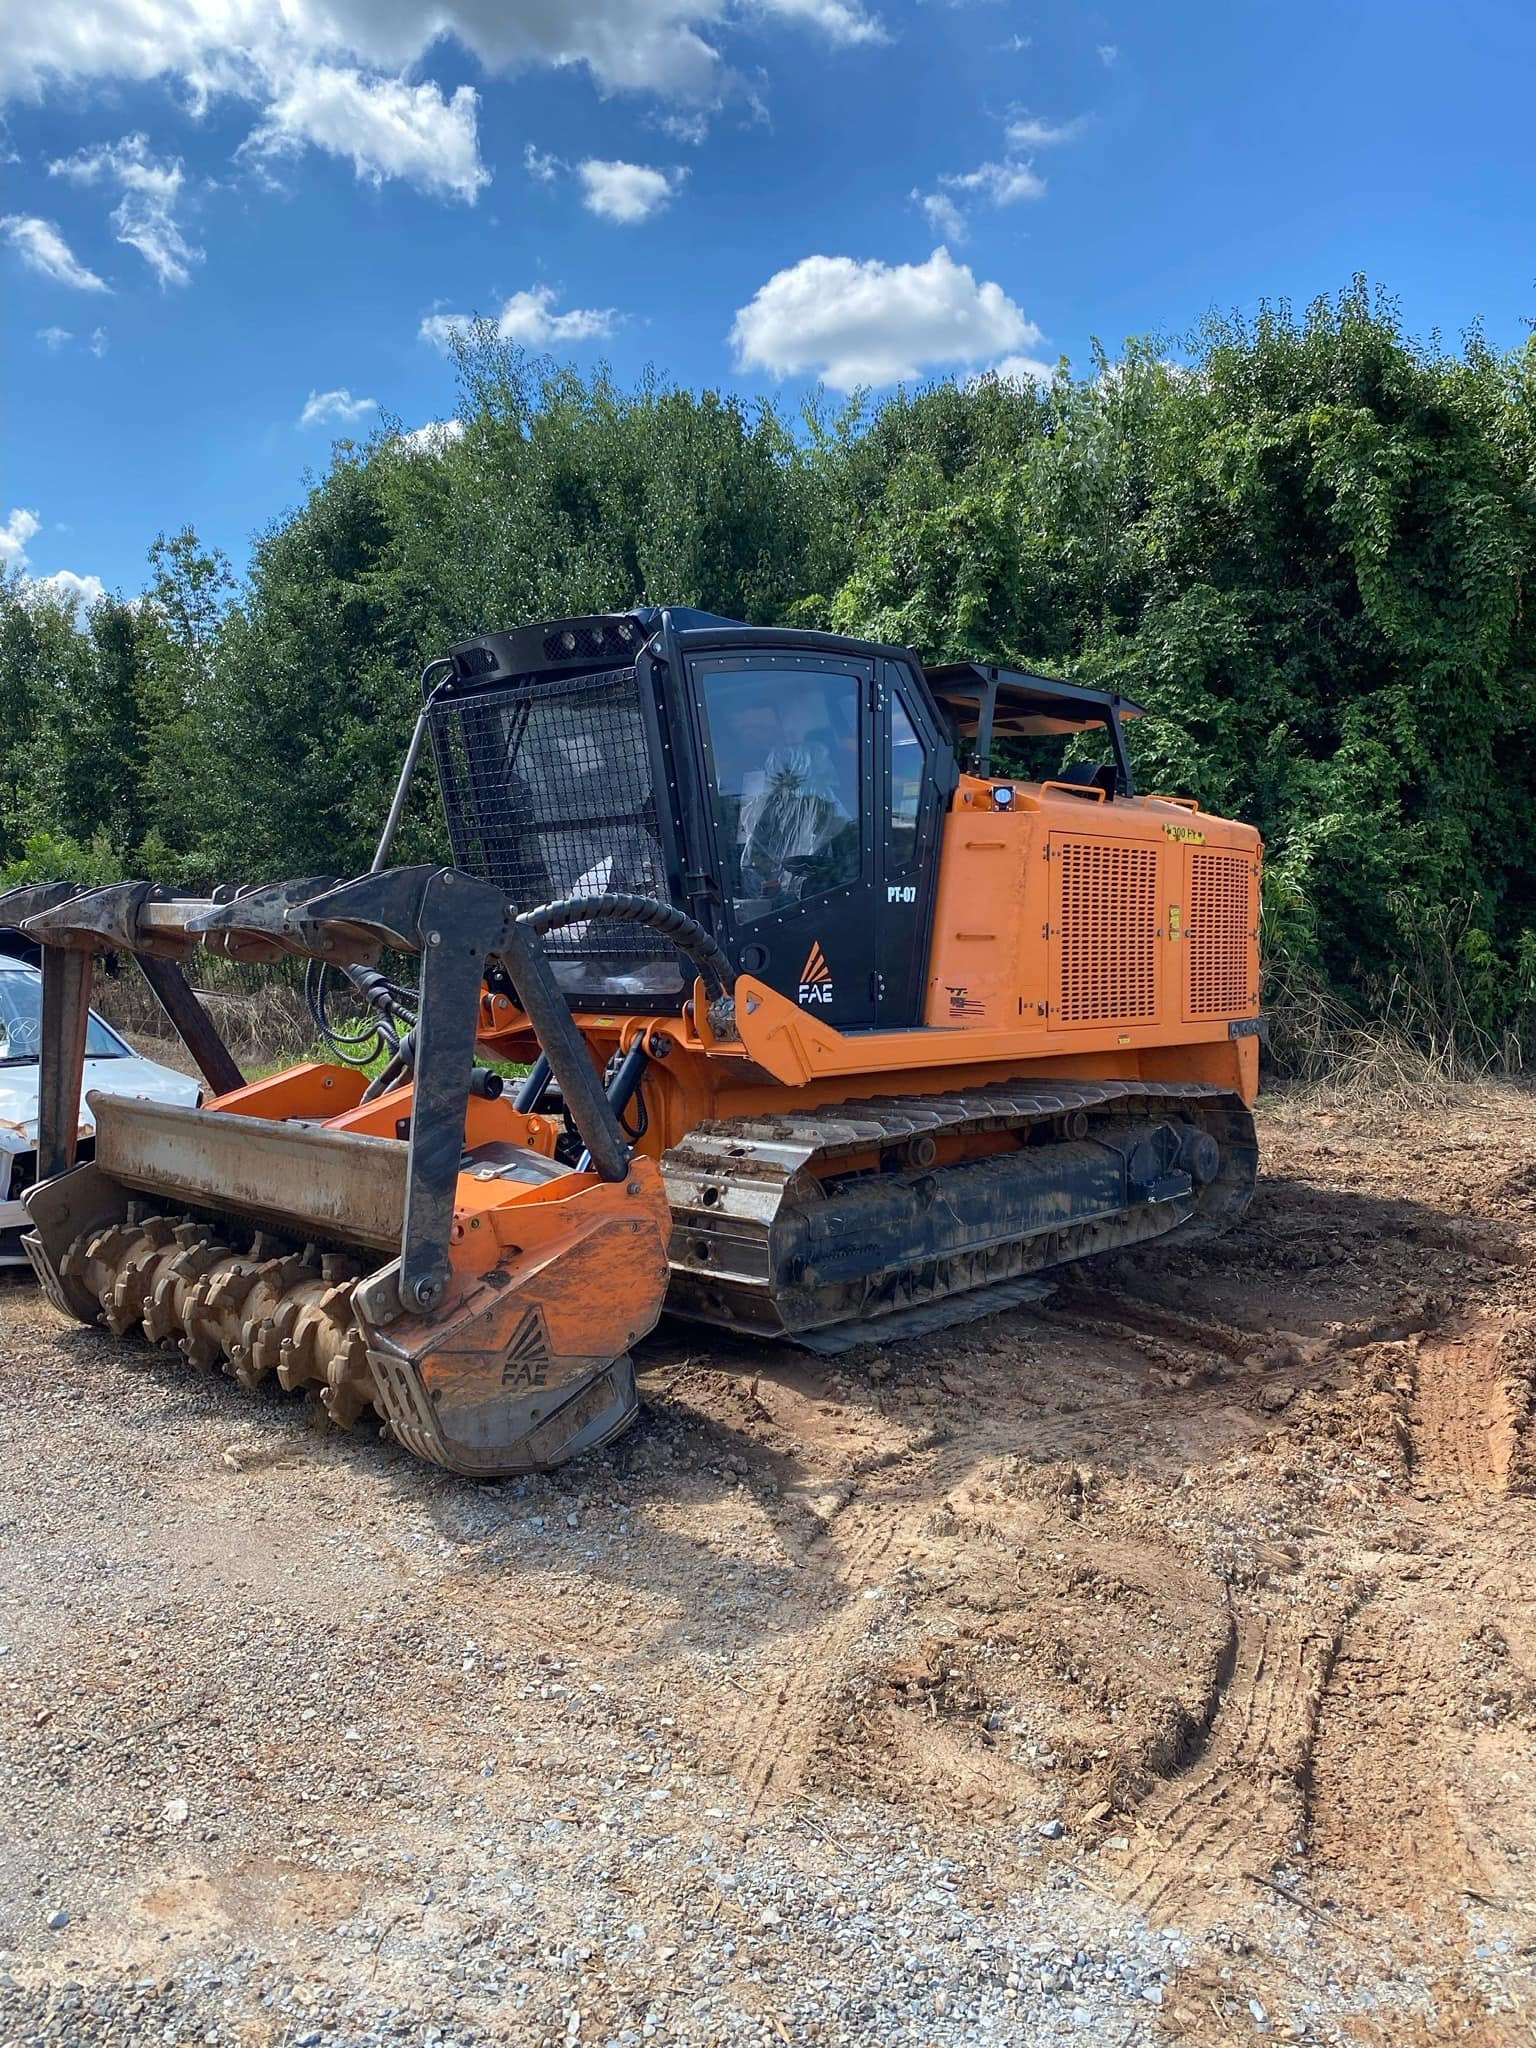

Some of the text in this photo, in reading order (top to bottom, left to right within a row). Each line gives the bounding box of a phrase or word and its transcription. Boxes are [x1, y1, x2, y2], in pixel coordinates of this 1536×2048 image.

[887, 886, 917, 903] PT-07
[798, 983, 833, 1004] FAE
[501, 1362, 549, 1386] FAE
